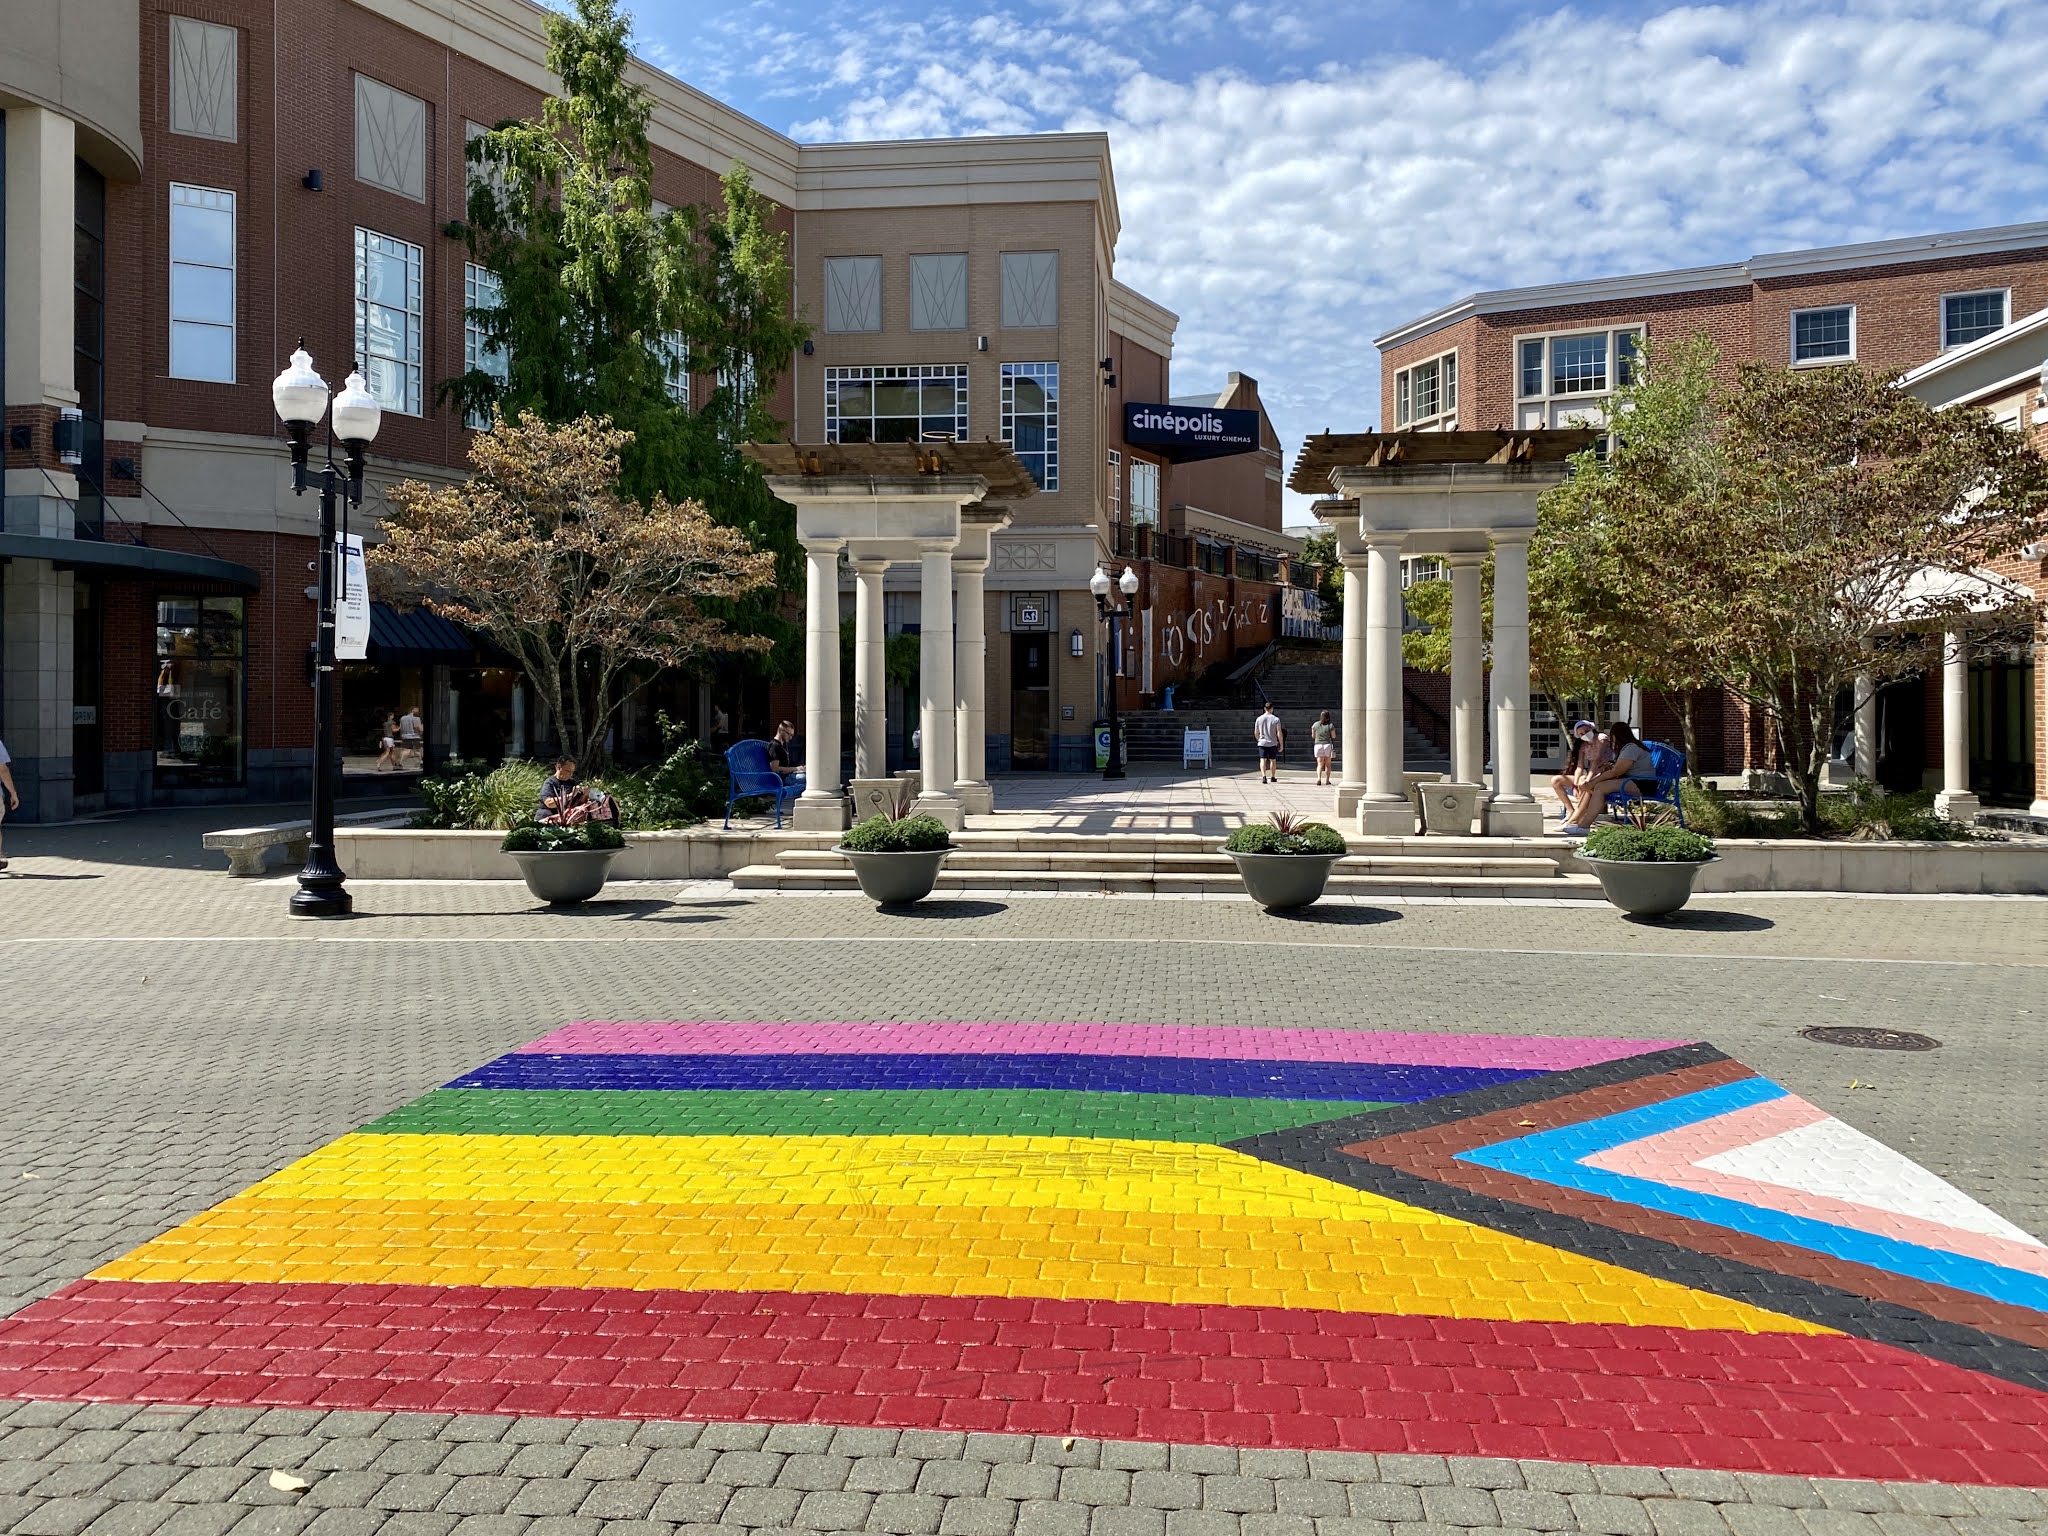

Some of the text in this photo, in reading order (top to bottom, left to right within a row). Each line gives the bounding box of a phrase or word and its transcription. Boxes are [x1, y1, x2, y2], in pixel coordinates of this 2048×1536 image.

[1132, 408, 1223, 435] cinépolis
[1221, 435, 1251, 443] CINEMAS
[166, 699, 222, 720] Café
